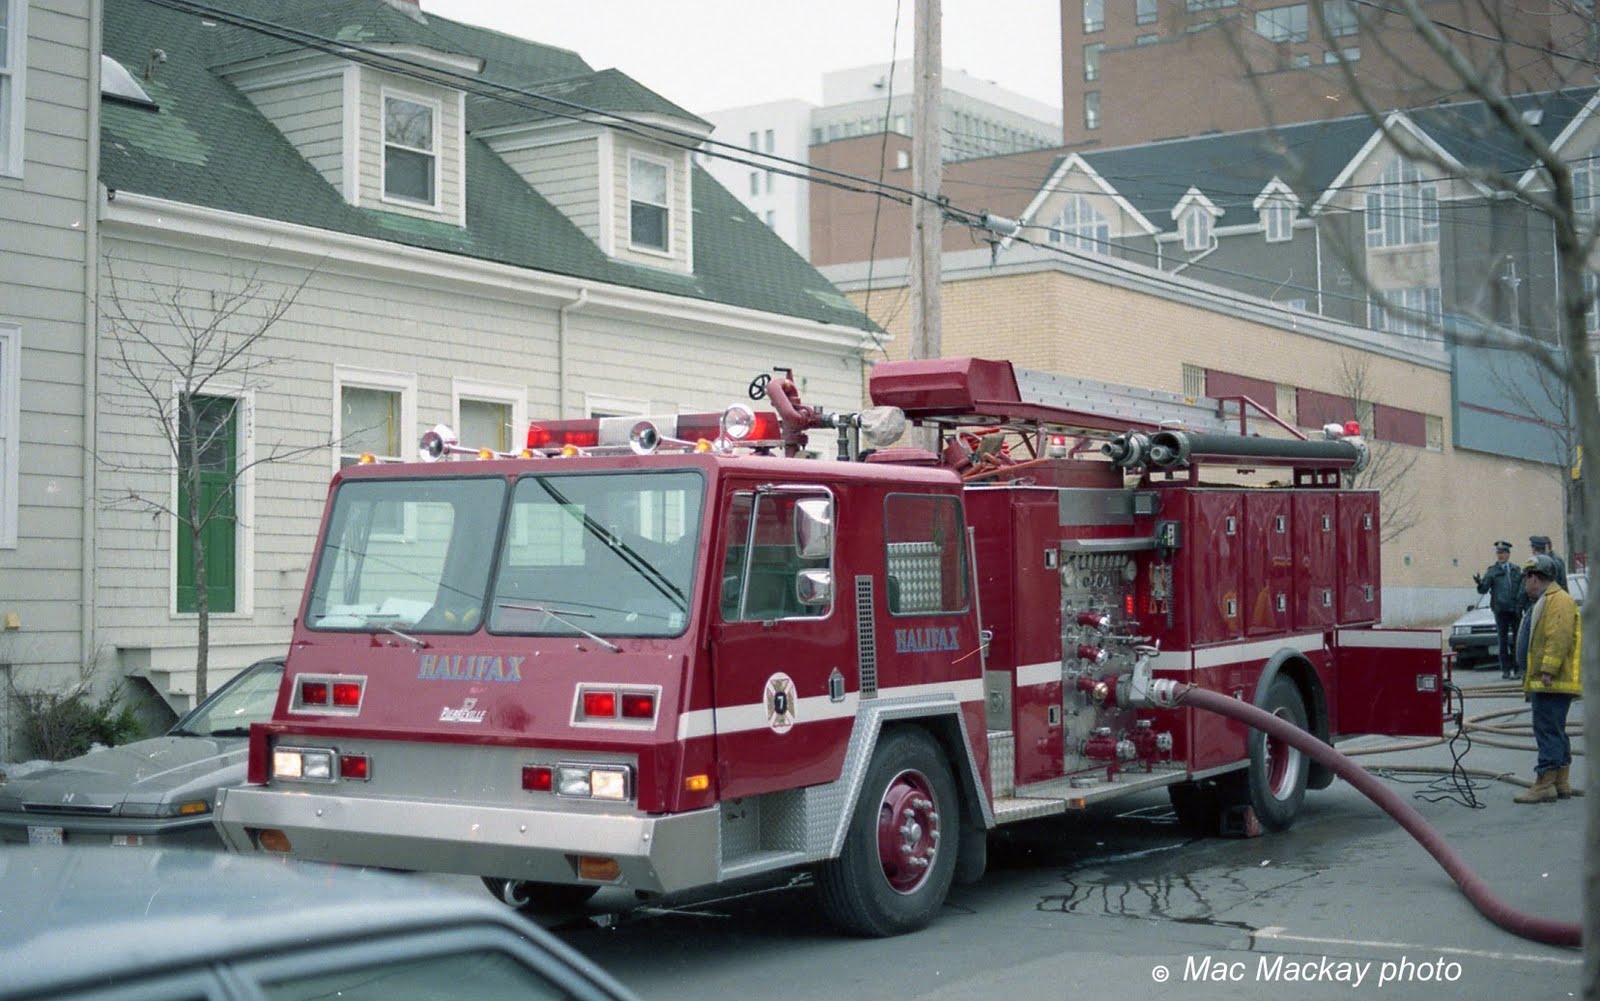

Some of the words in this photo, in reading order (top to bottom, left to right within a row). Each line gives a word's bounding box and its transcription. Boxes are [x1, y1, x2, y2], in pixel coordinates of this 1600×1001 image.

[895, 626, 960, 654] HALIFAX
[417, 654, 526, 682] HALIFAX
[776, 695, 785, 710] 7
